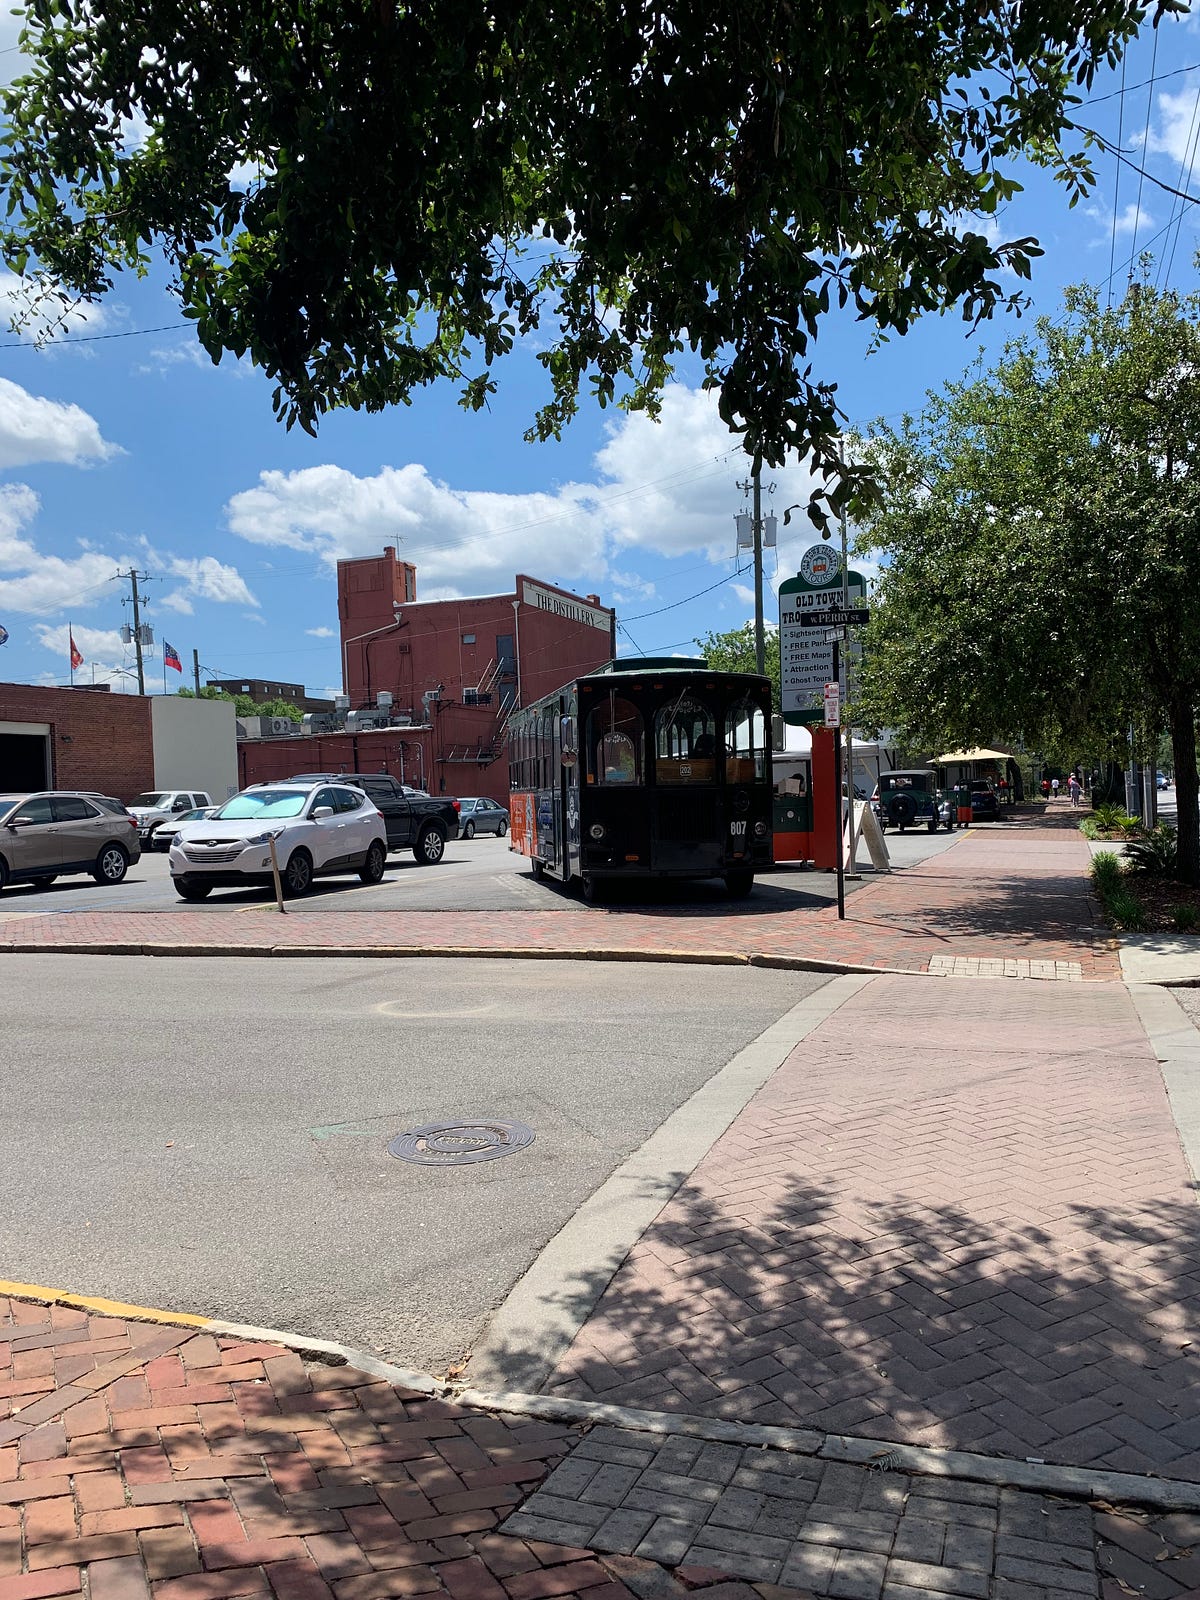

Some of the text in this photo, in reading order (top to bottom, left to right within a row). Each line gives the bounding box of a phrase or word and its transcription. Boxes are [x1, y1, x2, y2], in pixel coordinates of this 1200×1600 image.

[808, 572, 833, 583] TOURS
[796, 591, 844, 608] OLD TOWN
[536, 593, 595, 627] THE DISTILLERY
[819, 613, 849, 623] PERRY
[790, 652, 831, 661] FREE Maps
[790, 664, 829, 673] Attraction
[790, 675, 832, 685] Ghost Tours
[730, 821, 747, 836] 807
